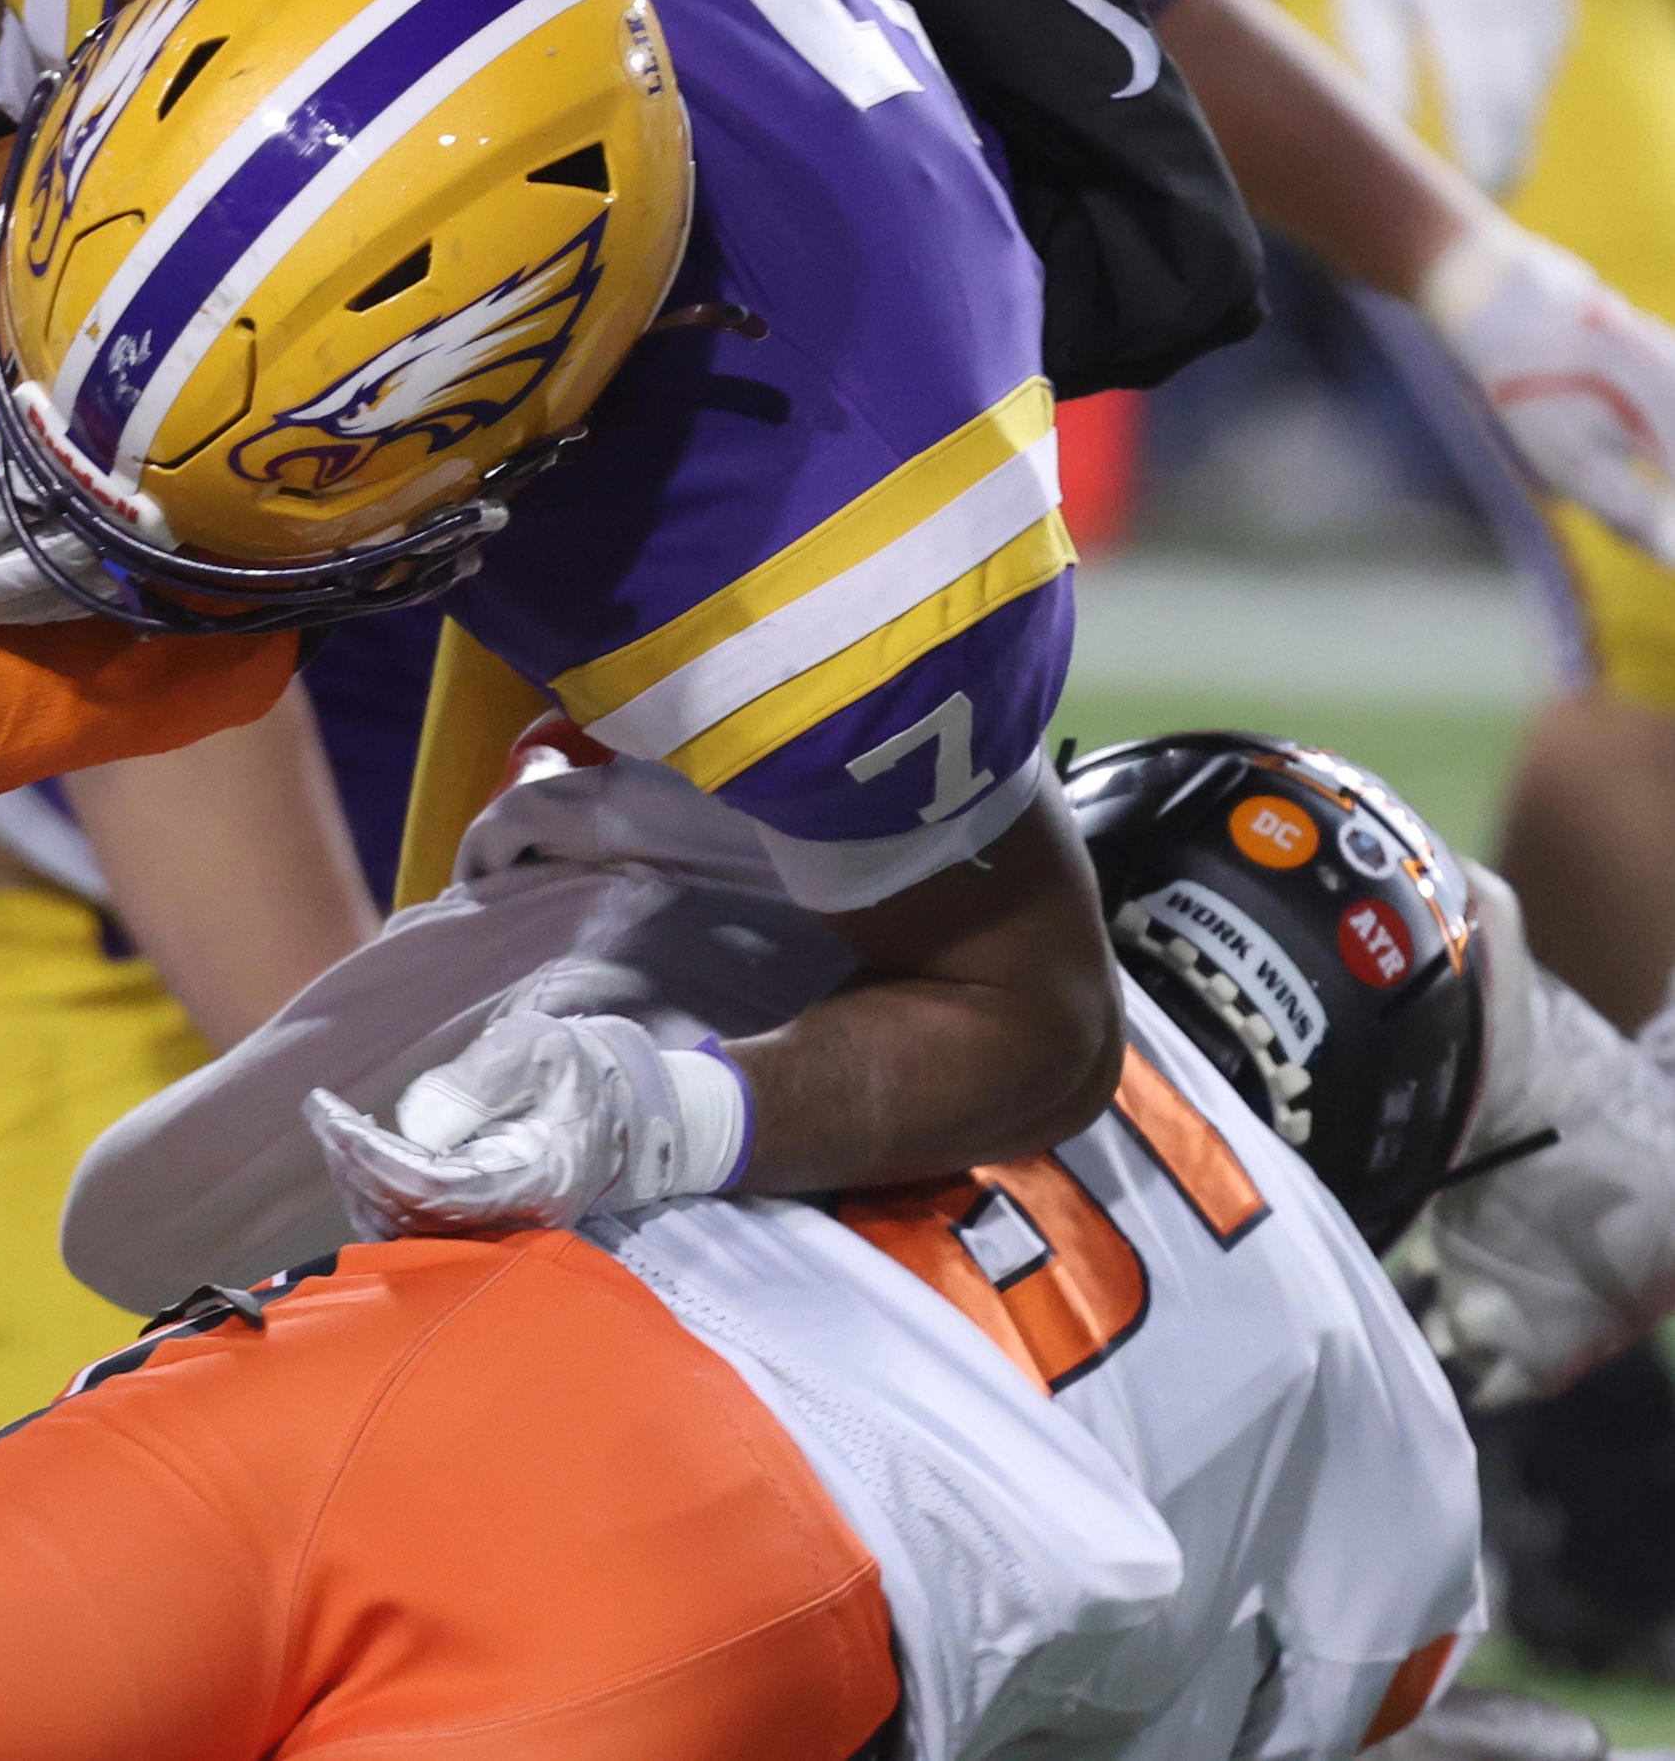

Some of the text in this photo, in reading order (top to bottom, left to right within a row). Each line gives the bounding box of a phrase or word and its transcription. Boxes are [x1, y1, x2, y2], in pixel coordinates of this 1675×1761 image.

[843, 690, 995, 824] 7
[1250, 807, 1303, 852] DC
[1166, 892, 1314, 1041] WORK WINS
[1347, 907, 1407, 980] AYR
